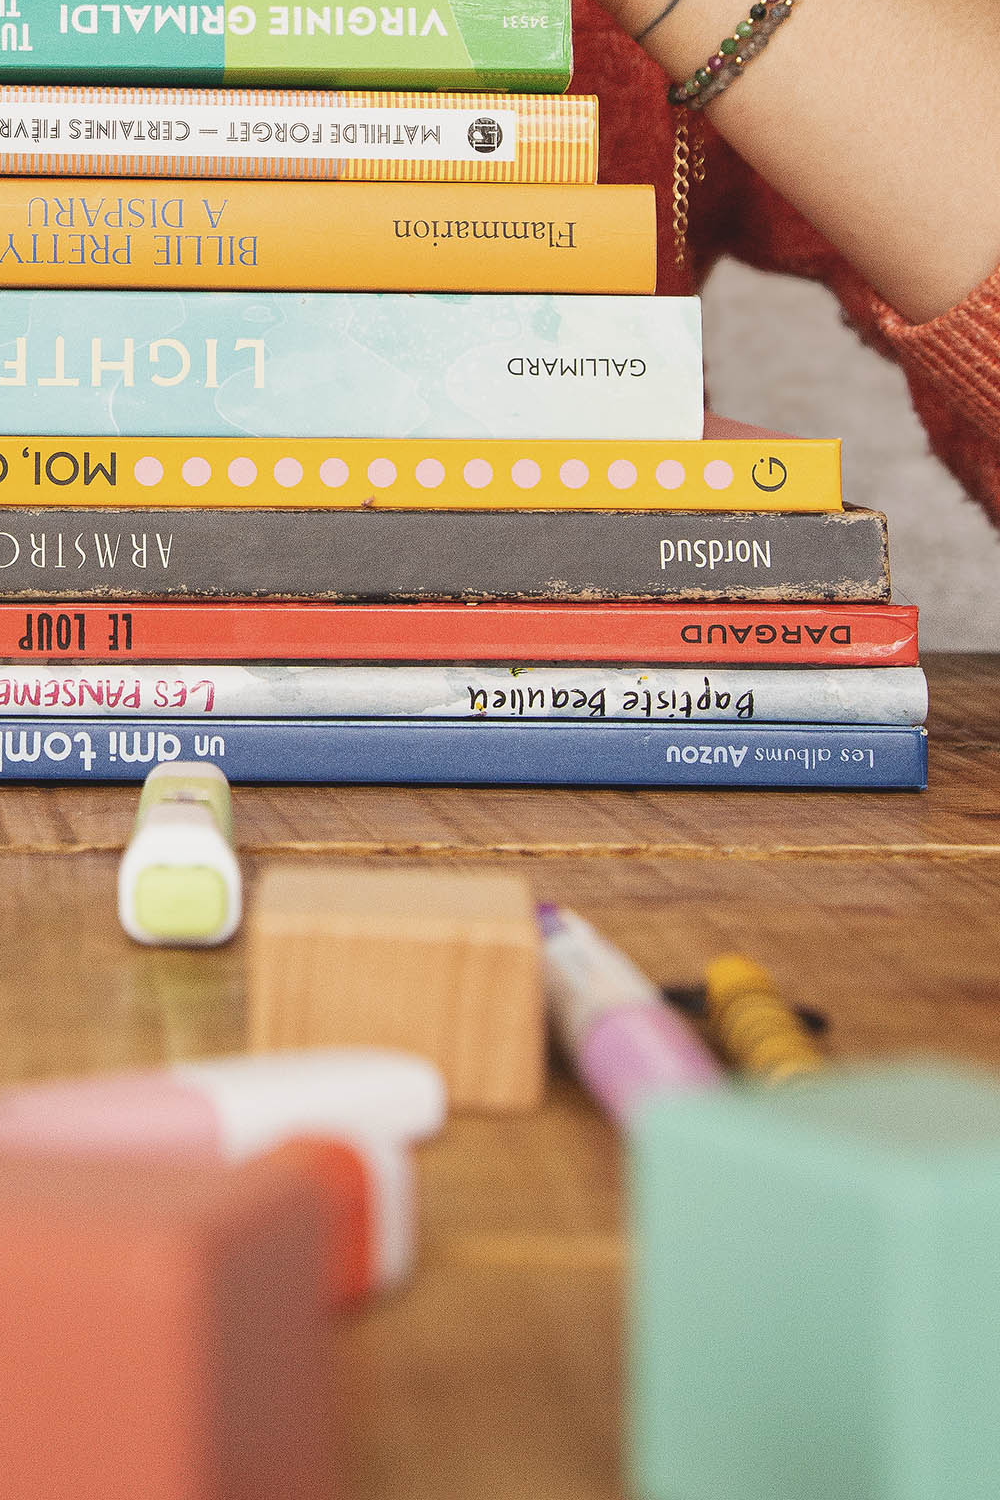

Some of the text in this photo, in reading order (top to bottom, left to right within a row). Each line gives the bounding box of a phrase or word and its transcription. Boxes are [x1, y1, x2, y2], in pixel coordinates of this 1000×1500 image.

[59, 4, 447, 36] VIRGINIE GRIMALDI
[502, 15, 549, 28] 34531
[2, 22, 33, 51] TU
[68, 118, 191, 141] CERTAINES
[226, 121, 322, 143] FORGET
[329, 122, 441, 144] MATHILDE
[27, 197, 227, 227] A DISPARU
[393, 220, 577, 248] Flammarion
[154, 235, 258, 266] BILLIE
[507, 357, 647, 377] GALLIMARD
[22, 449, 118, 487] MOI,
[660, 538, 772, 568] NordSud
[19, 613, 86, 650] LOUP
[107, 614, 133, 650] LE
[680, 624, 851, 644] DARGAUD
[466, 676, 755, 719] Baptiste Beaulieu
[108, 731, 181, 763] ami
[194, 735, 225, 756] un
[754, 747, 831, 769] albums
[838, 748, 875, 768] Les
